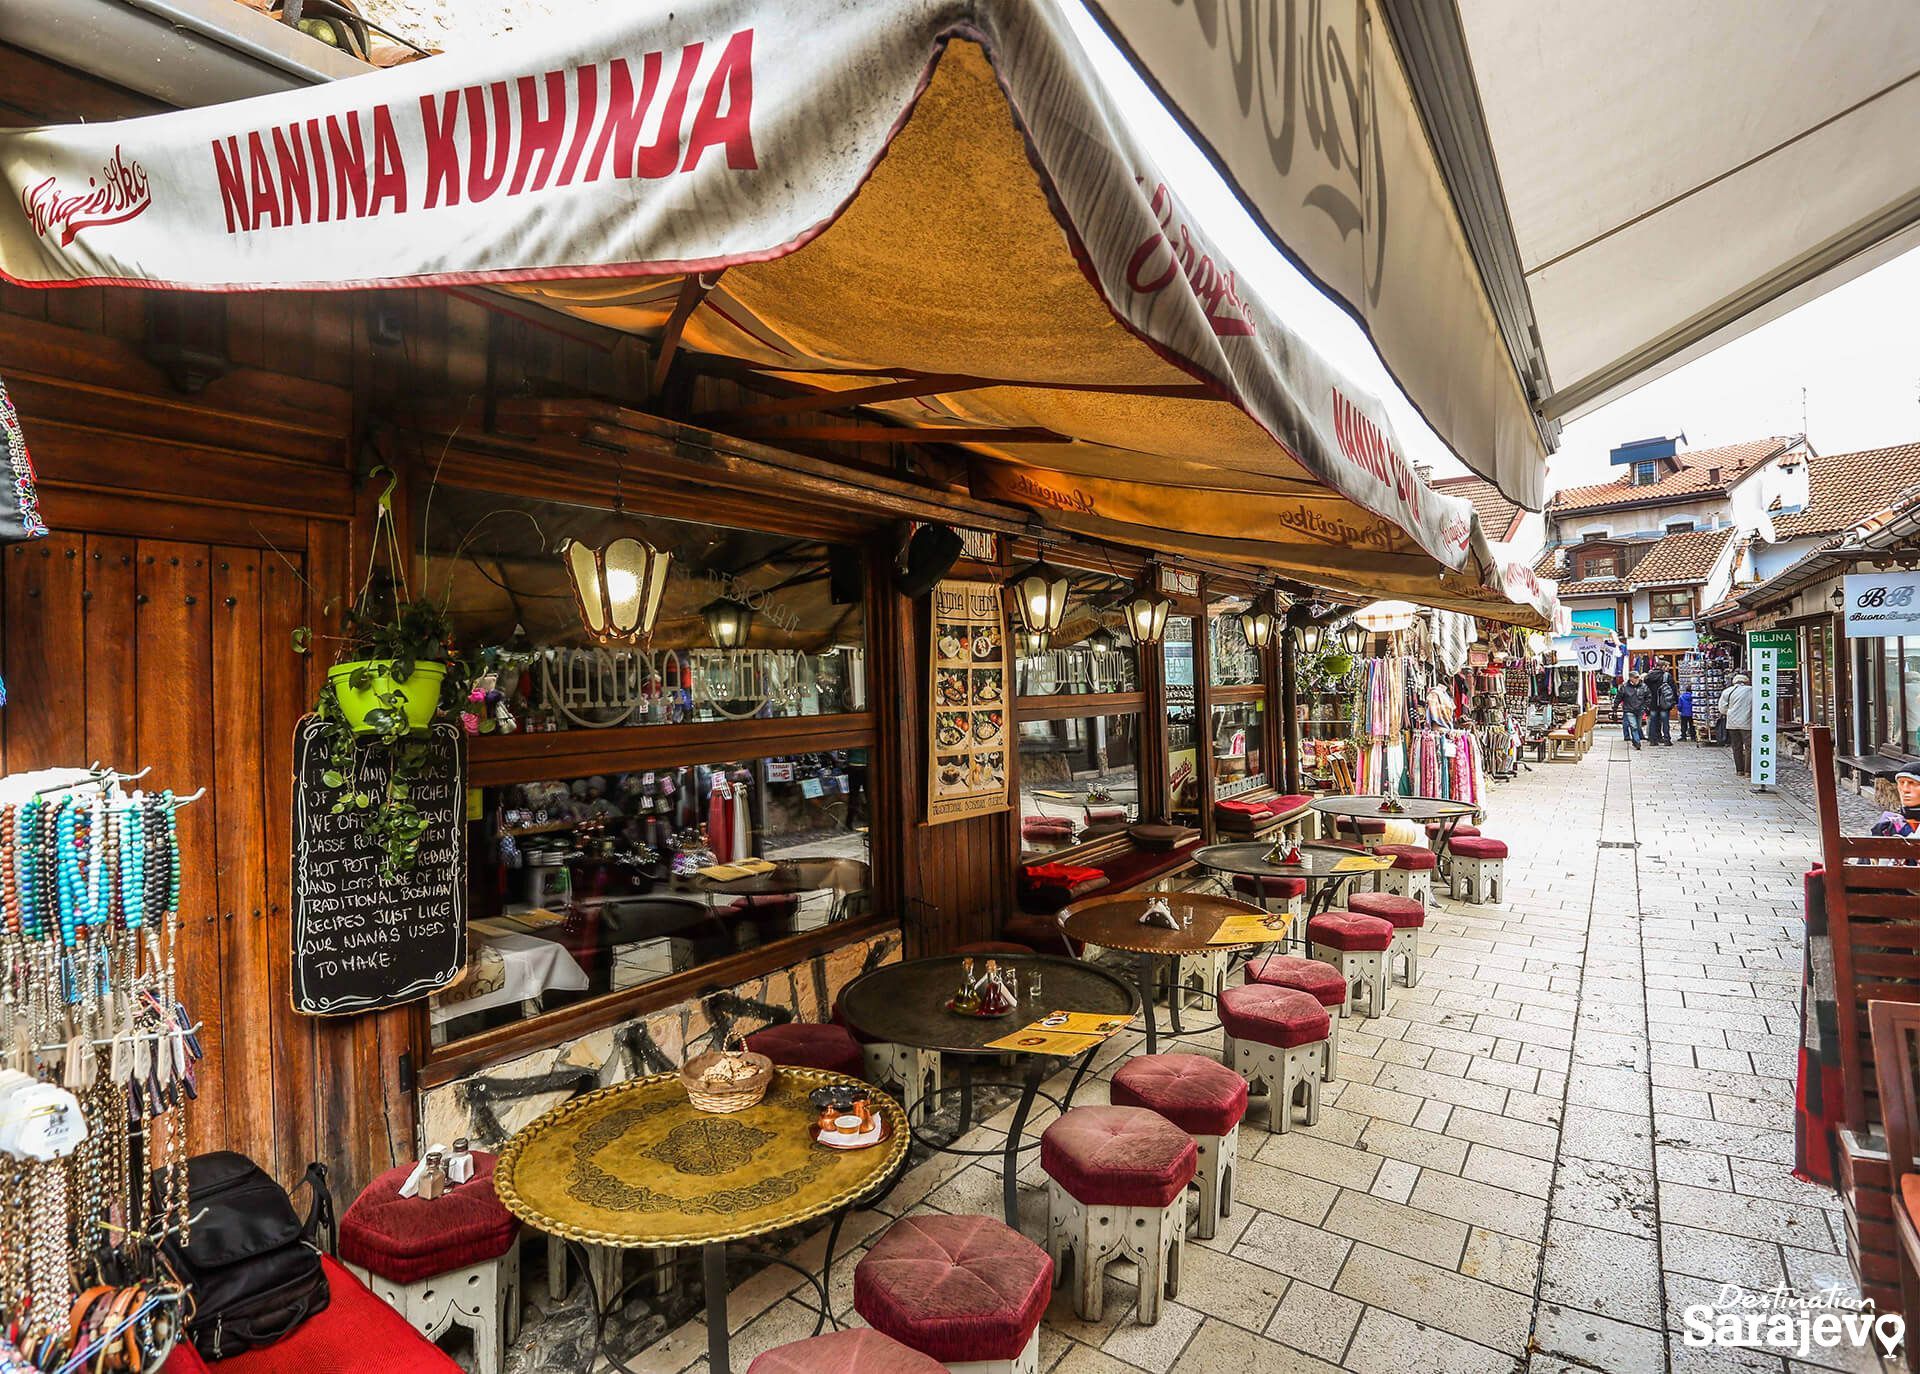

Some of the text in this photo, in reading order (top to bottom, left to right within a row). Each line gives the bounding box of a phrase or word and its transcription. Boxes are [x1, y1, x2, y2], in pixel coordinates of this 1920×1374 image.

[212, 28, 758, 234] NANINA KUHINJA
[1849, 612, 1886, 621] Buono
[1751, 633, 1792, 642] BILJNA
[1581, 650, 1598, 666] 10
[539, 646, 684, 728] NANINA
[1760, 650, 1771, 781] HERBAL SHOP
[308, 813, 333, 835] WE
[307, 880, 336, 897] AND
[341, 874, 373, 892] LOTS
[378, 870, 412, 889] MORE
[415, 868, 432, 884] OF
[310, 859, 340, 878] HOT
[304, 882, 452, 915] TRADITIONAL BOSNIAN
[306, 901, 451, 935] RECIPES JUST LIKE
[304, 937, 337, 955] OUR
[408, 921, 446, 939] USED
[315, 952, 391, 979] TO MAKE
